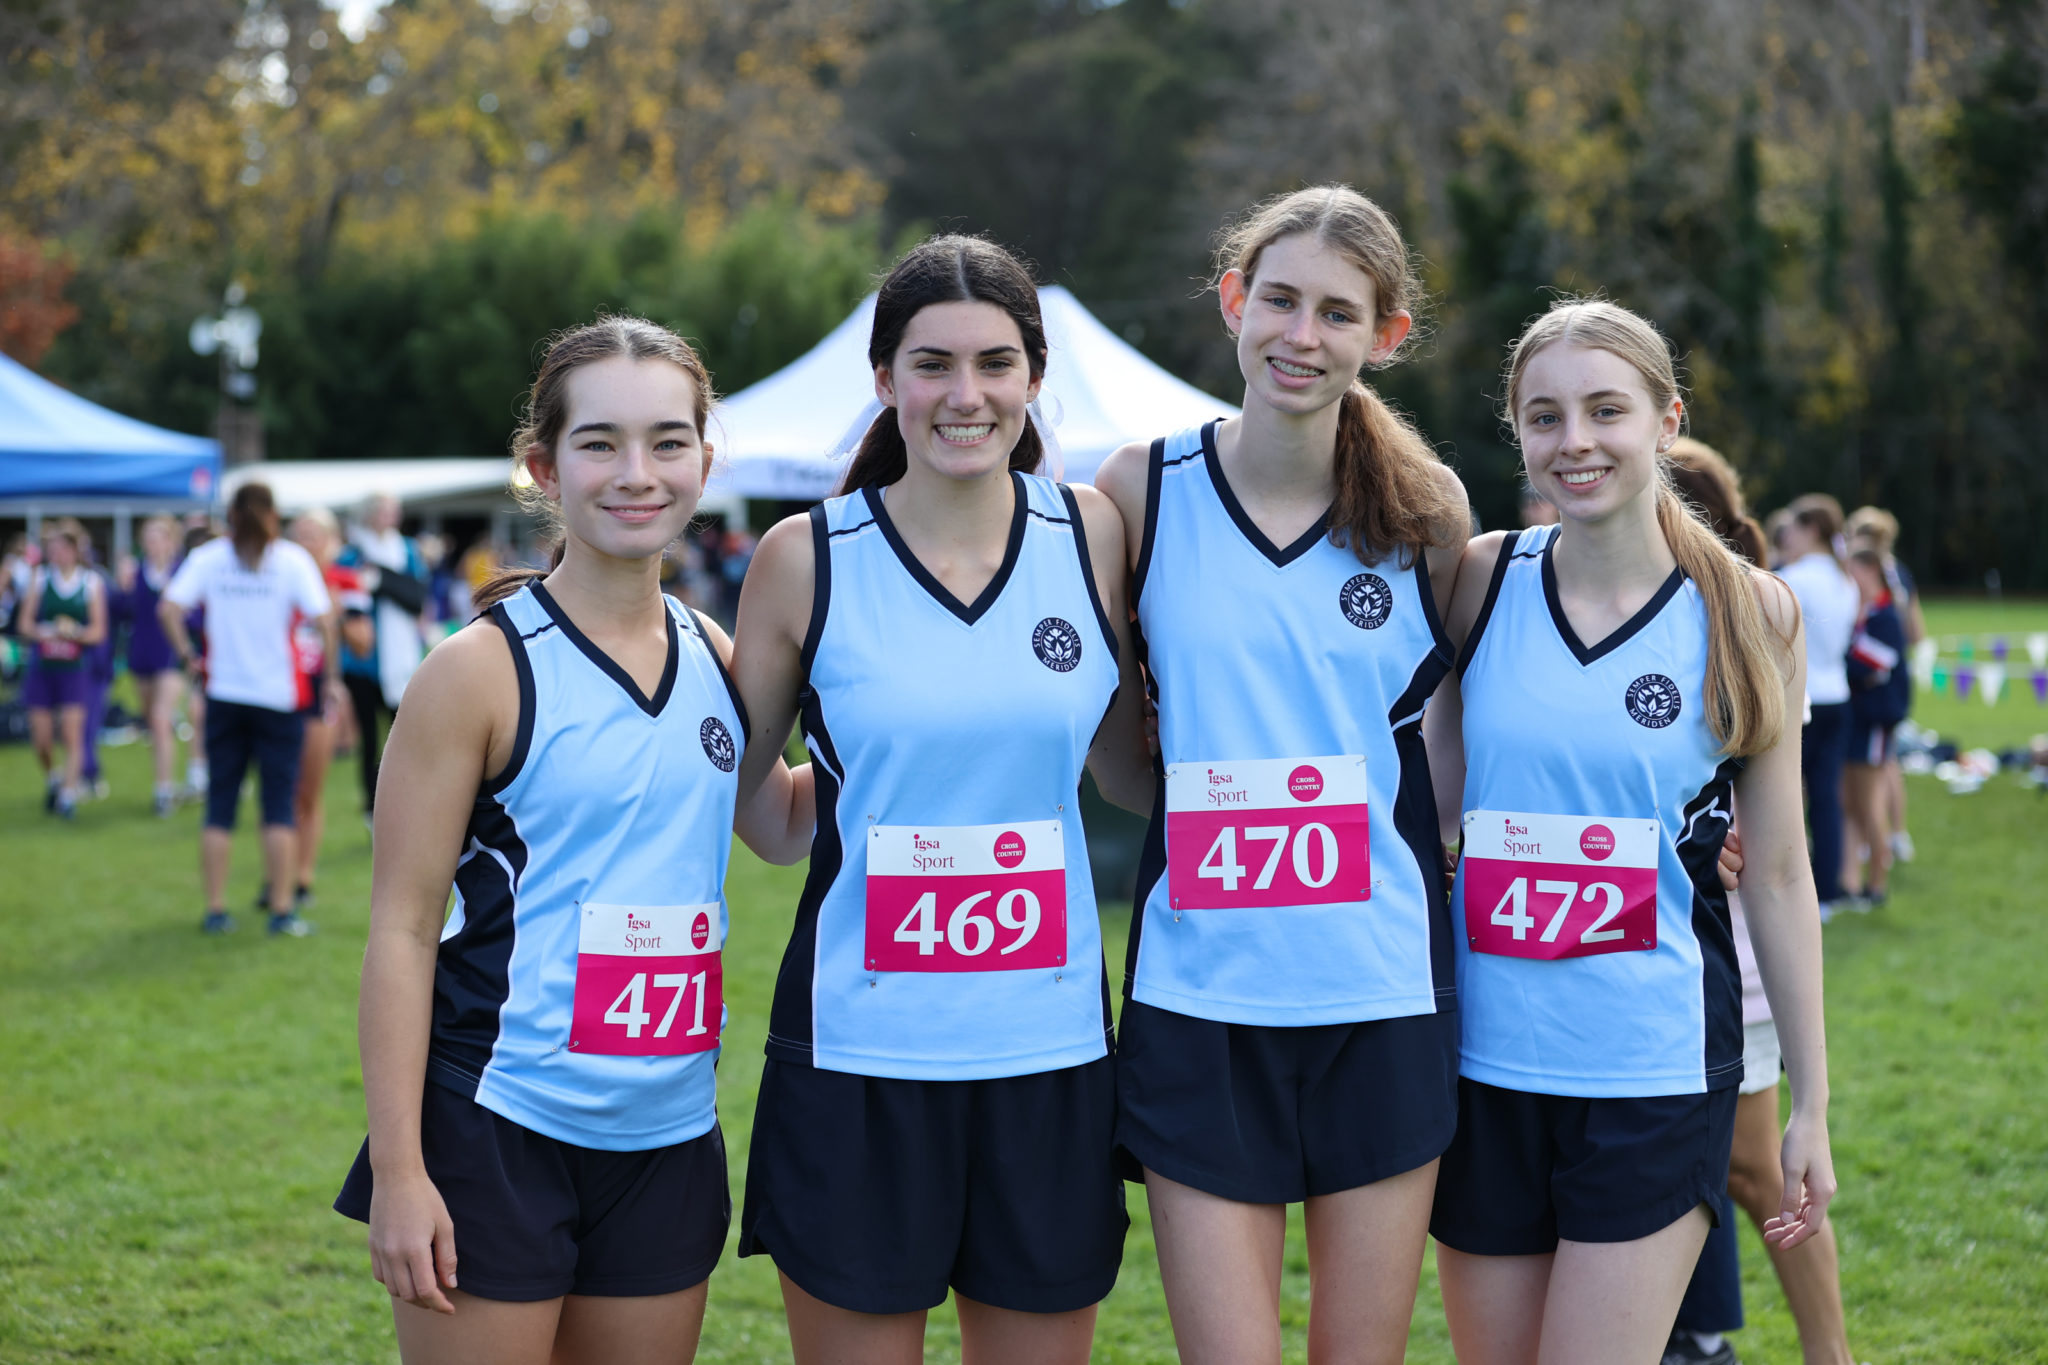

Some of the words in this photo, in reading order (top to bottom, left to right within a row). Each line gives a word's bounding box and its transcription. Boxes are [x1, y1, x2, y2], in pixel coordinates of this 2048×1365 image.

[1341, 575, 1366, 600] SEMPER
[1371, 576, 1391, 607] FIDELIS
[1346, 612, 1384, 628] MERIDEN
[1056, 619, 1080, 648] FIDELIS
[1043, 657, 1078, 671] MERIDEN
[1627, 675, 1656, 697] SEMPER
[1661, 677, 1680, 709] FIDELIS
[1630, 708, 1670, 727] MERIDEN
[1208, 769, 1232, 786] igsa
[1208, 789, 1248, 806] Sport
[1505, 819, 1528, 836] igsa
[914, 834, 940, 851] igsa
[1504, 839, 1541, 856] Sport
[913, 854, 955, 871] Sport
[1198, 822, 1339, 890] 470
[1491, 877, 1624, 944] 472
[627, 913, 651, 931] igsa
[894, 888, 1041, 956] 469
[625, 934, 661, 952] Sport
[604, 970, 707, 1038] 471
